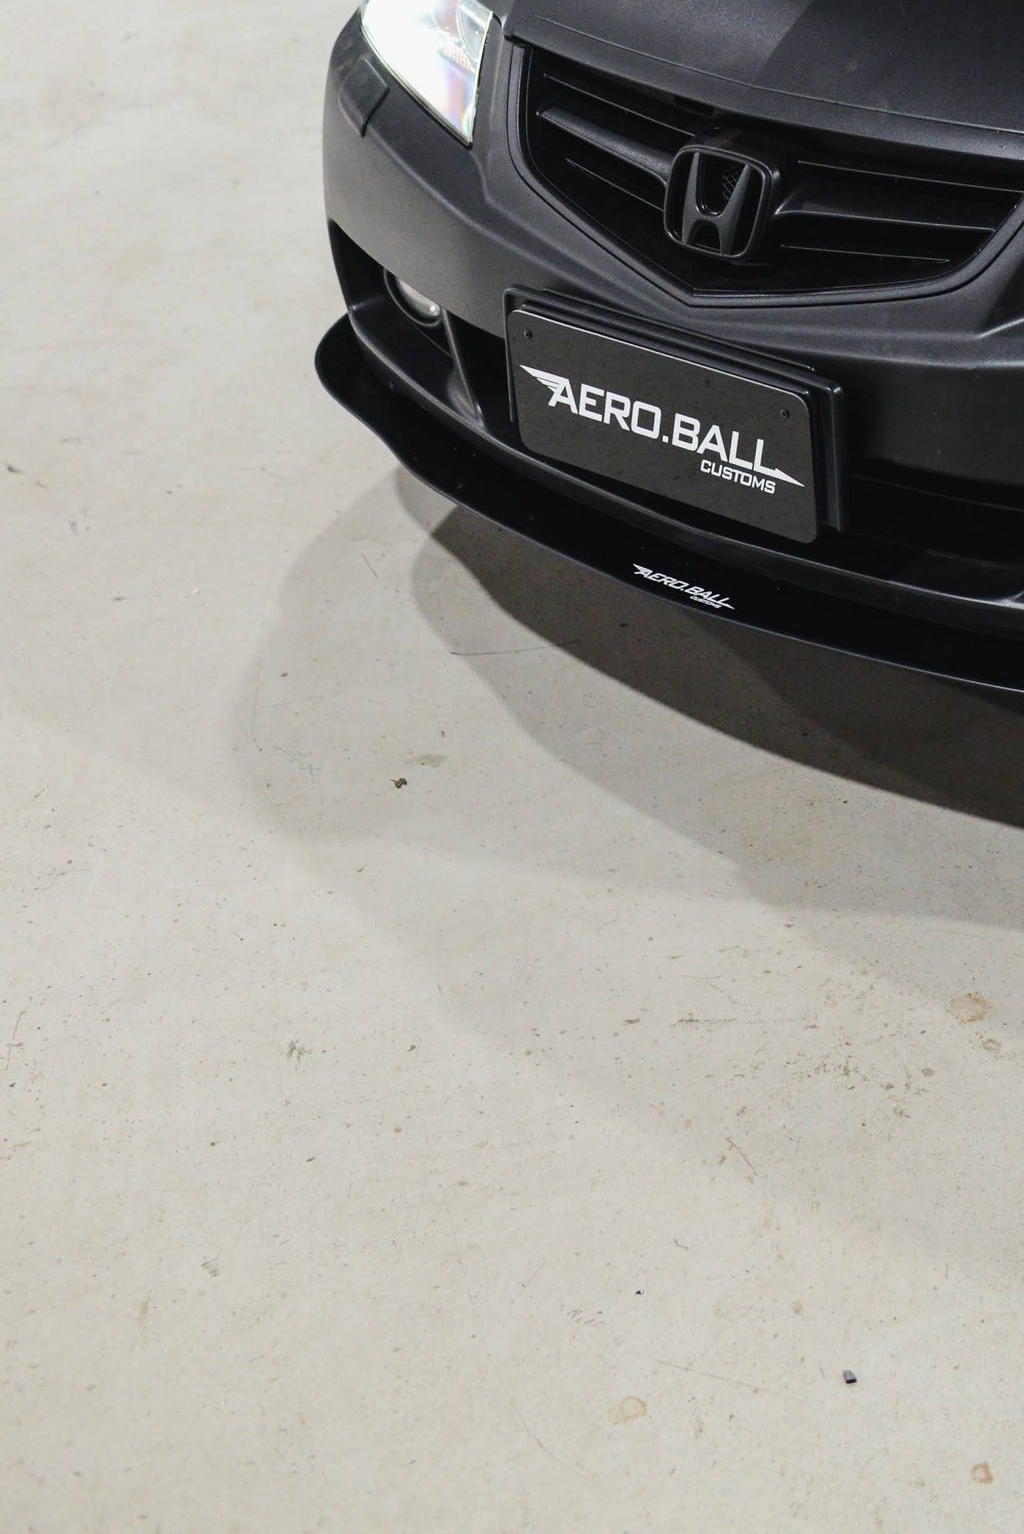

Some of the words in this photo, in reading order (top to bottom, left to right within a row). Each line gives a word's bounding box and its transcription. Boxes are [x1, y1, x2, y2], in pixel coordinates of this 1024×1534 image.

[520, 364, 805, 487] AERO.BALL
[700, 459, 776, 494] CUSTOMS
[633, 563, 735, 610] AERO.BALL
